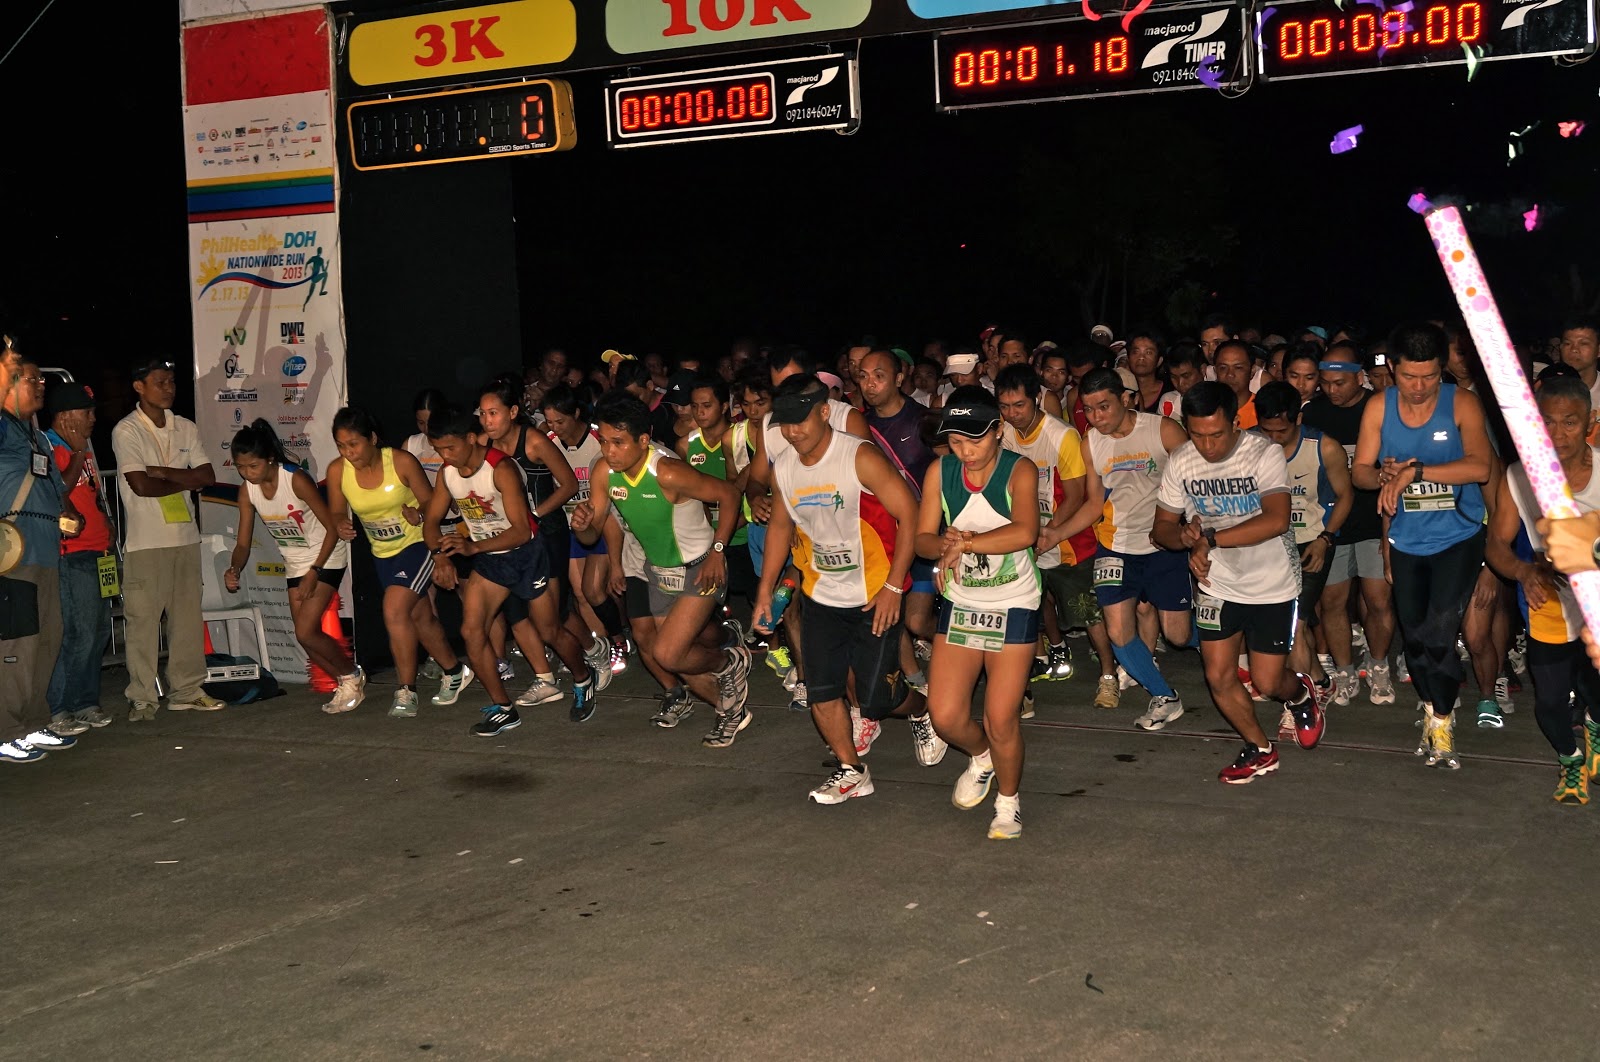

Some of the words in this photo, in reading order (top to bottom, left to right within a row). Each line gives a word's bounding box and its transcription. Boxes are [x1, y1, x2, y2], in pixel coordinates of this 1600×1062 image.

[662, 0, 812, 37] 10K
[1144, 22, 1195, 37] macjarod
[414, 15, 505, 67] 3K
[1184, 41, 1226, 64] TIMER
[786, 73, 820, 86] macjarod
[622, 83, 769, 130] 00:00.00
[786, 104, 843, 123] 09218460247
[489, 144, 512, 153] SEIKO
[512, 143, 531, 151] Sports
[227, 253, 285, 270] NATIONWIDE
[286, 252, 306, 266] RUN
[282, 266, 303, 280] 2013
[210, 286, 250, 302] 2.17.13
[280, 322, 305, 337] DWIZ
[284, 358, 306, 377] Pfizer
[949, 408, 973, 416] RBK
[1191, 476, 1259, 497] CONQUERED
[1214, 491, 1262, 515] SKYWAY
[101, 571, 116, 587] CREW
[962, 572, 1020, 588] MASTERS
[953, 611, 1003, 629] 18-0429
